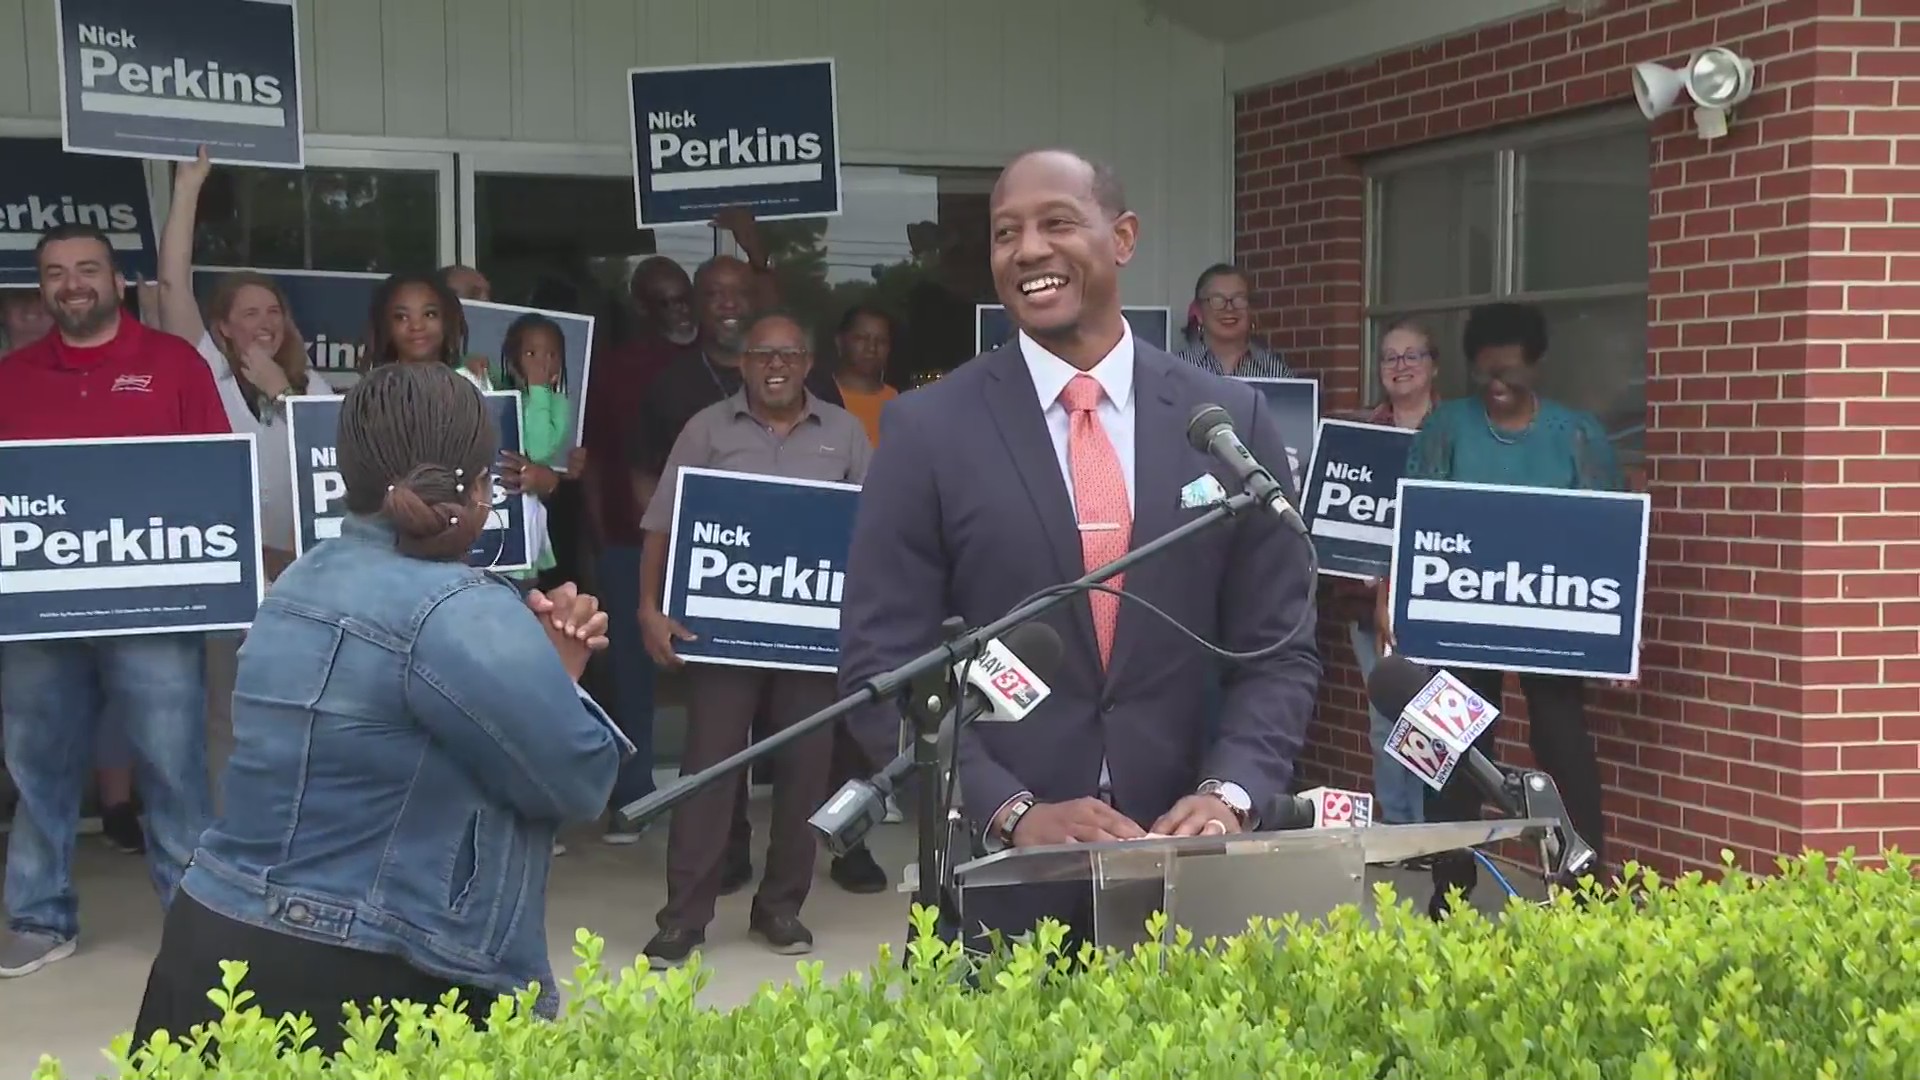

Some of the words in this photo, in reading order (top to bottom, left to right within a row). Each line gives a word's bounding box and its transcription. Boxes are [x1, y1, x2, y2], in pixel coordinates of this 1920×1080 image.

[78, 24, 137, 48] Nick
[80, 48, 282, 105] Perkins
[649, 110, 697, 130] Nick
[650, 127, 822, 170] Perkins
[0, 195, 138, 230] rkins
[1325, 461, 1373, 483] Nick
[0, 494, 67, 517] Nick
[0, 517, 238, 567] Perkins
[693, 521, 751, 547] Nick
[1414, 529, 1472, 554] Nick
[688, 547, 845, 602] Perki
[1411, 554, 1621, 610] Perkins
[995, 670, 1028, 698] 31
[1424, 687, 1473, 738] 19
[1387, 719, 1411, 750] NEWS
[1401, 730, 1440, 778] 19
[1323, 793, 1352, 827] 8
